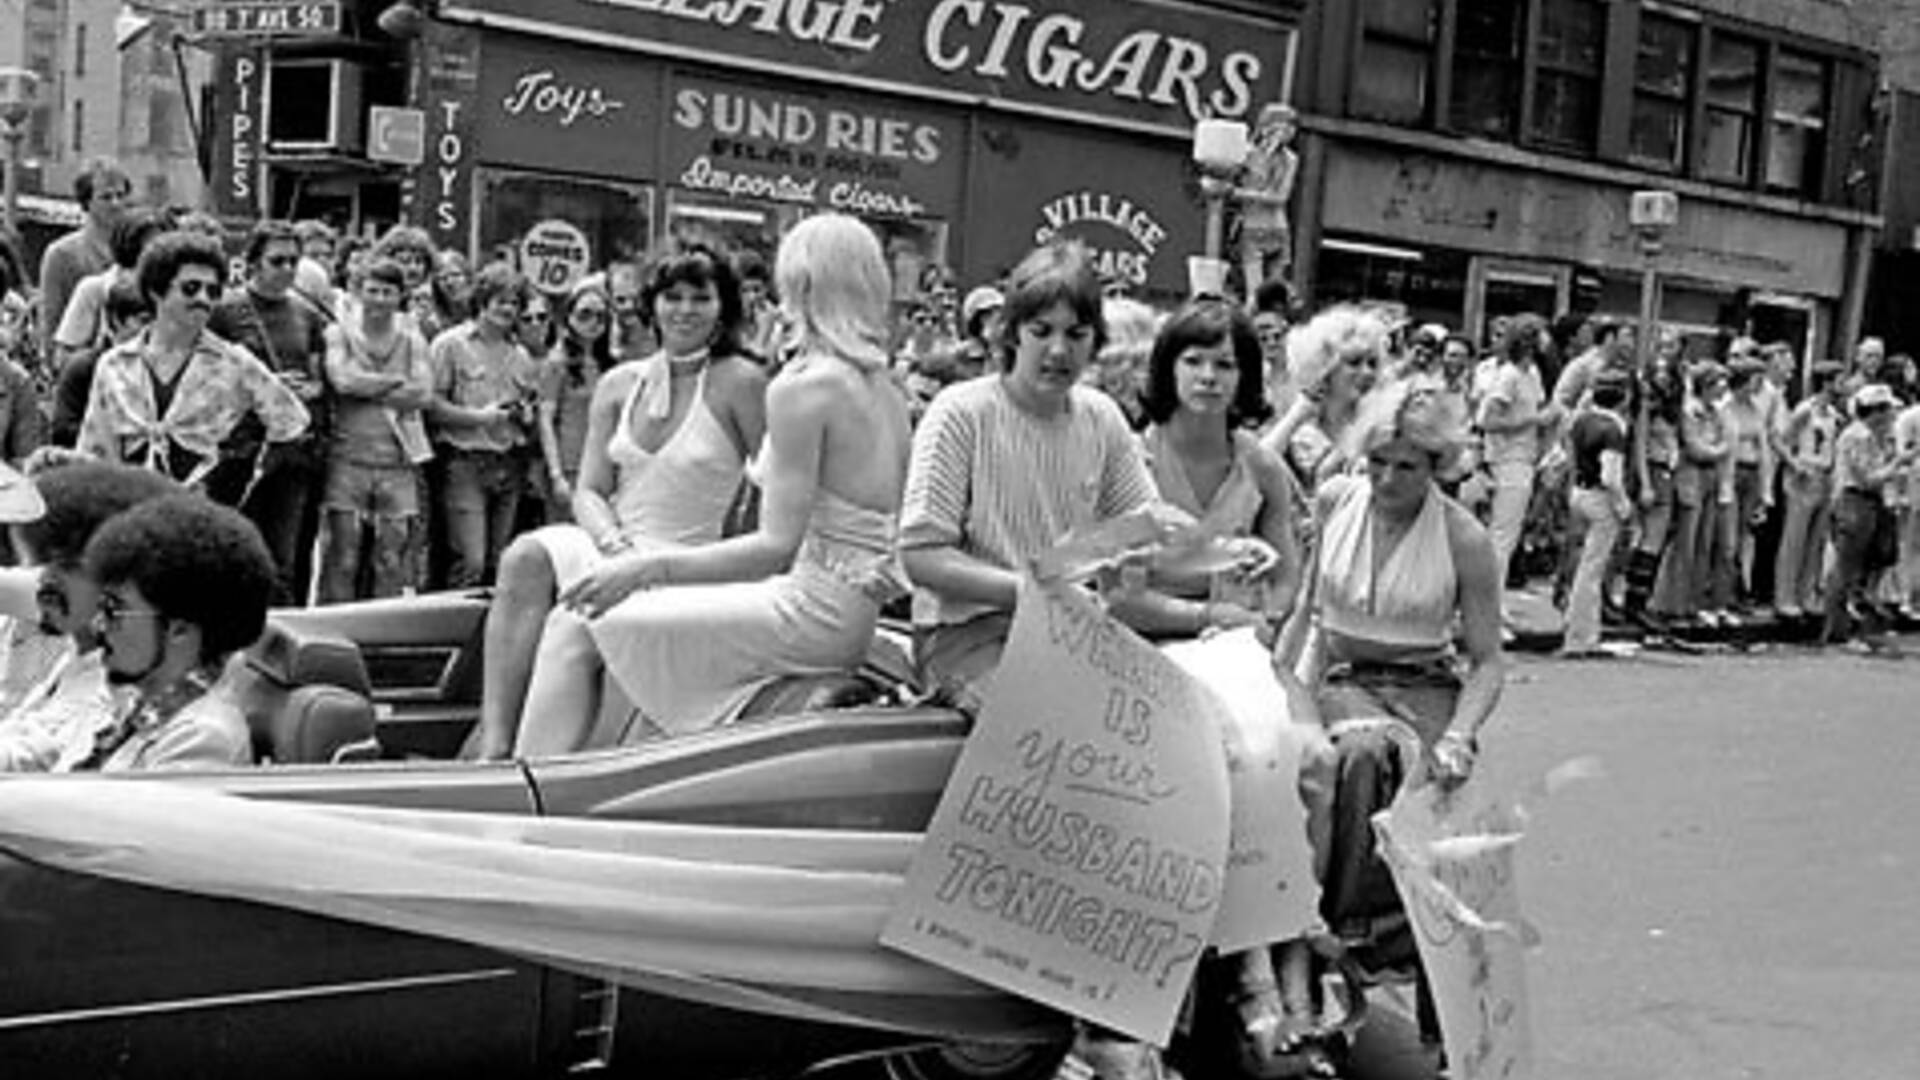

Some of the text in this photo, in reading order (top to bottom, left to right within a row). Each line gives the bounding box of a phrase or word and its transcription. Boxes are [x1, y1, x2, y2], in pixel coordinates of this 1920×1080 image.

[503, 71, 624, 126] Toys
[926, 0, 1261, 122] CIGARS
[233, 58, 255, 197] PIPES
[439, 100, 461, 230] TOYS
[674, 89, 940, 163] SUNDRIES
[1043, 191, 1168, 255] VILLAGE
[1104, 687, 1152, 745] IS
[1016, 729, 1181, 806] your
[959, 775, 1220, 914] HUSBAND
[935, 842, 1202, 989] TONIGHT?
